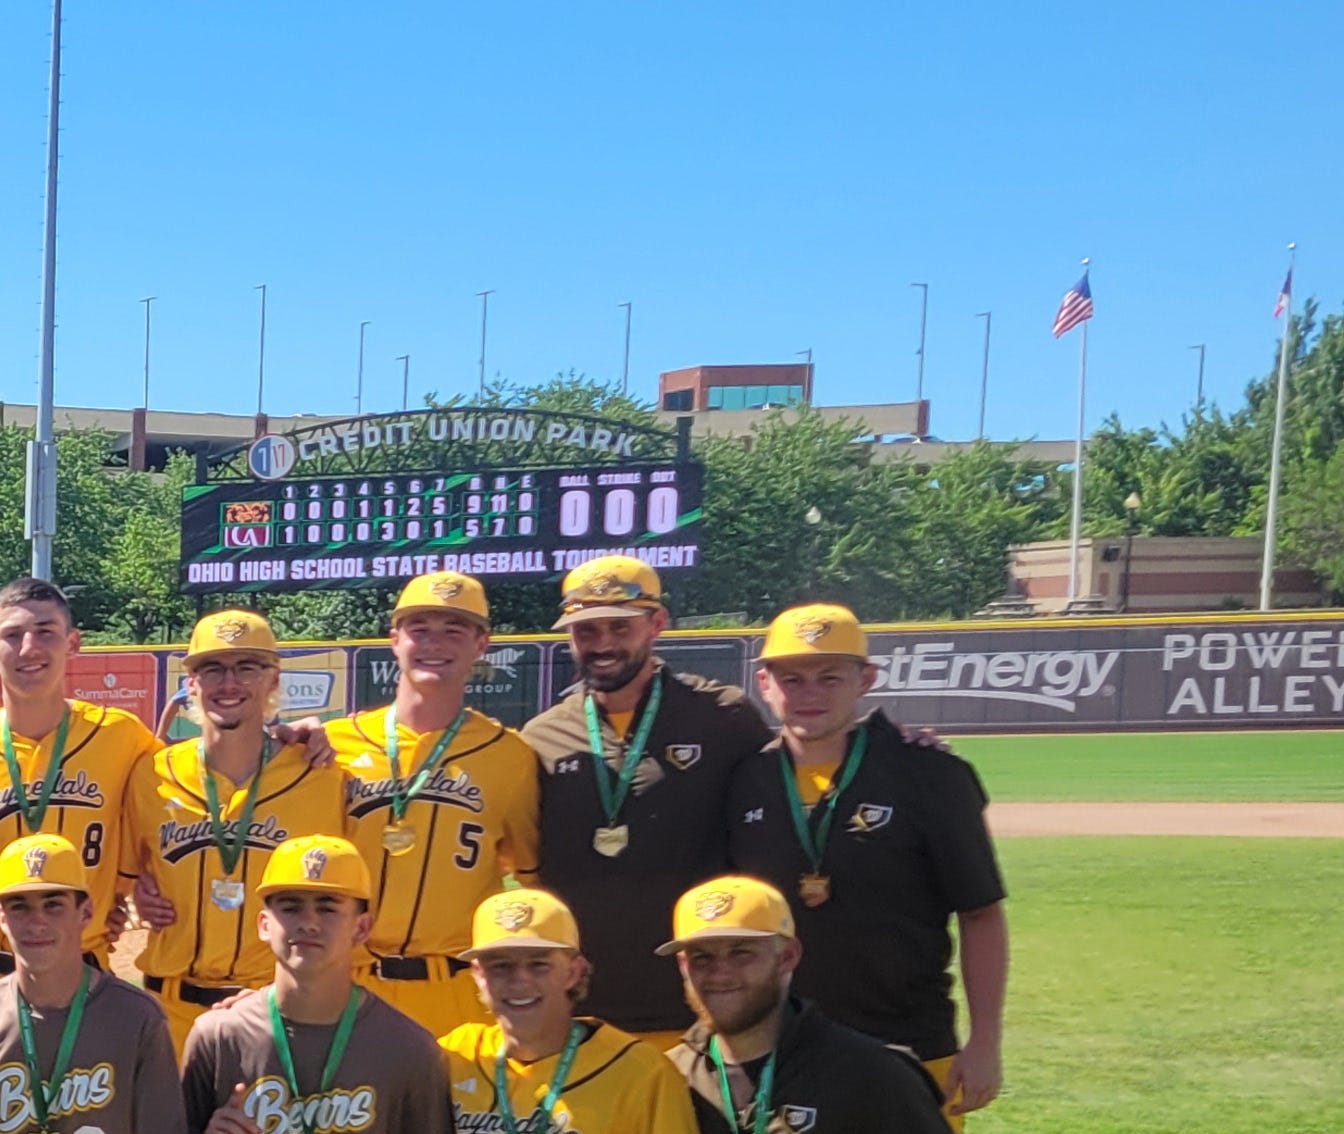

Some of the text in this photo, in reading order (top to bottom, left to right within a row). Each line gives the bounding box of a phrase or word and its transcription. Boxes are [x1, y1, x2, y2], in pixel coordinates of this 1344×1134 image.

[299, 422, 414, 461] CREDIT
[428, 419, 535, 442] UNION
[544, 424, 637, 457] PARK
[283, 492, 533, 521] 0 0 0 1 1 2 5 9 11 0
[560, 487, 678, 536] 0 0 0
[284, 526, 294, 544] 1
[307, 525, 320, 543] 0
[331, 524, 344, 542] 0
[357, 522, 370, 541] 0
[381, 522, 394, 540] 3
[407, 521, 420, 539] 0
[434, 520, 443, 538] 1
[466, 519, 480, 537] 5
[493, 518, 505, 536] 7
[518, 516, 533, 535] 0
[188, 562, 234, 583] OHIO
[240, 560, 286, 582] HIGH
[290, 557, 367, 581] SCHOOL
[372, 554, 439, 577] STATE
[444, 551, 547, 574] BASEBALL
[868, 643, 1120, 698] stEnergy
[1162, 631, 1344, 672] POWE
[74, 687, 148, 699] SummaCare
[464, 684, 513, 694] GROUP
[346, 767, 483, 805] Waydale
[82, 821, 105, 869] 8
[158, 815, 289, 852] Waynale
[453, 820, 486, 872] 5
